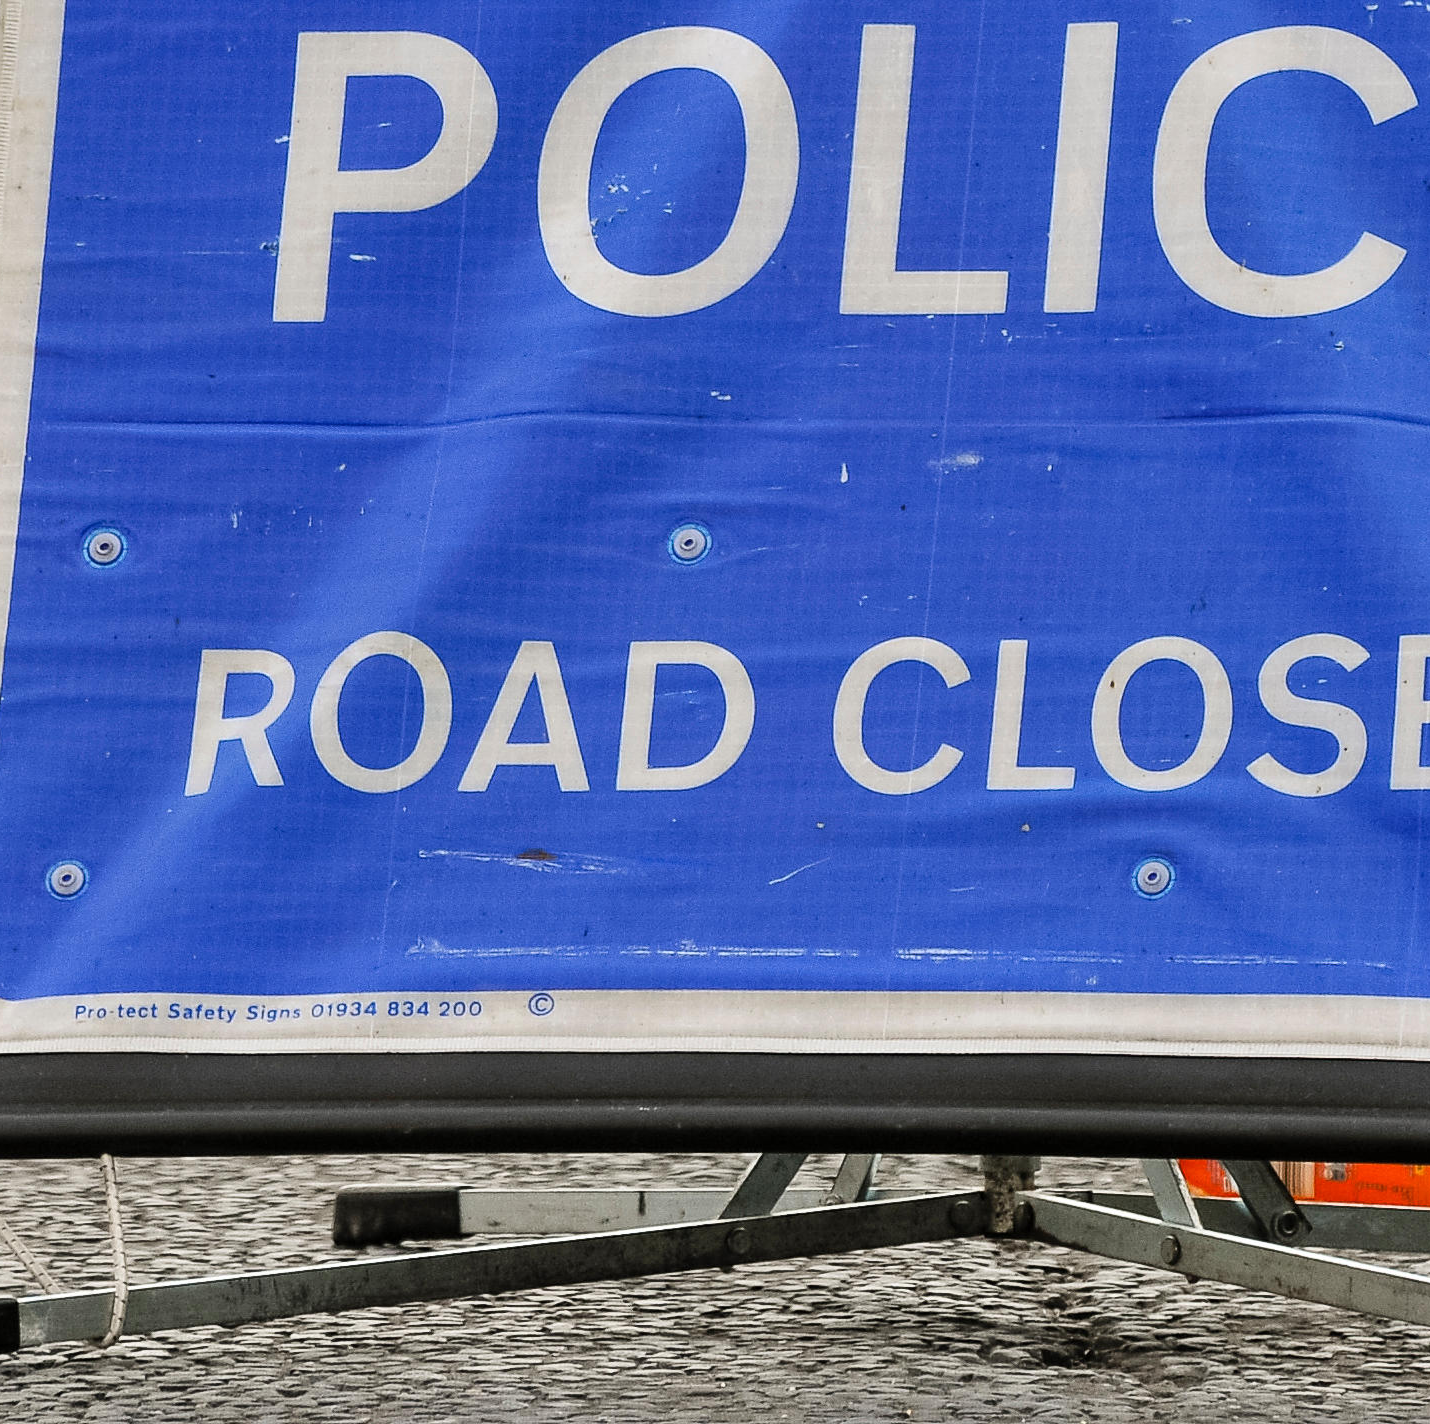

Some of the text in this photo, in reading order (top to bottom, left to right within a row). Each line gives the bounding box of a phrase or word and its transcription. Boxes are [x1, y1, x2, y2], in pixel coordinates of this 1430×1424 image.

[184, 630, 758, 798] ROAD
[75, 1003, 159, 1019] Pro-tect
[167, 1003, 237, 1024] Safety
[246, 1004, 302, 1023] Signs
[311, 1000, 377, 1018] 01934
[387, 1000, 430, 1017] 834
[438, 1000, 483, 1017] 200
